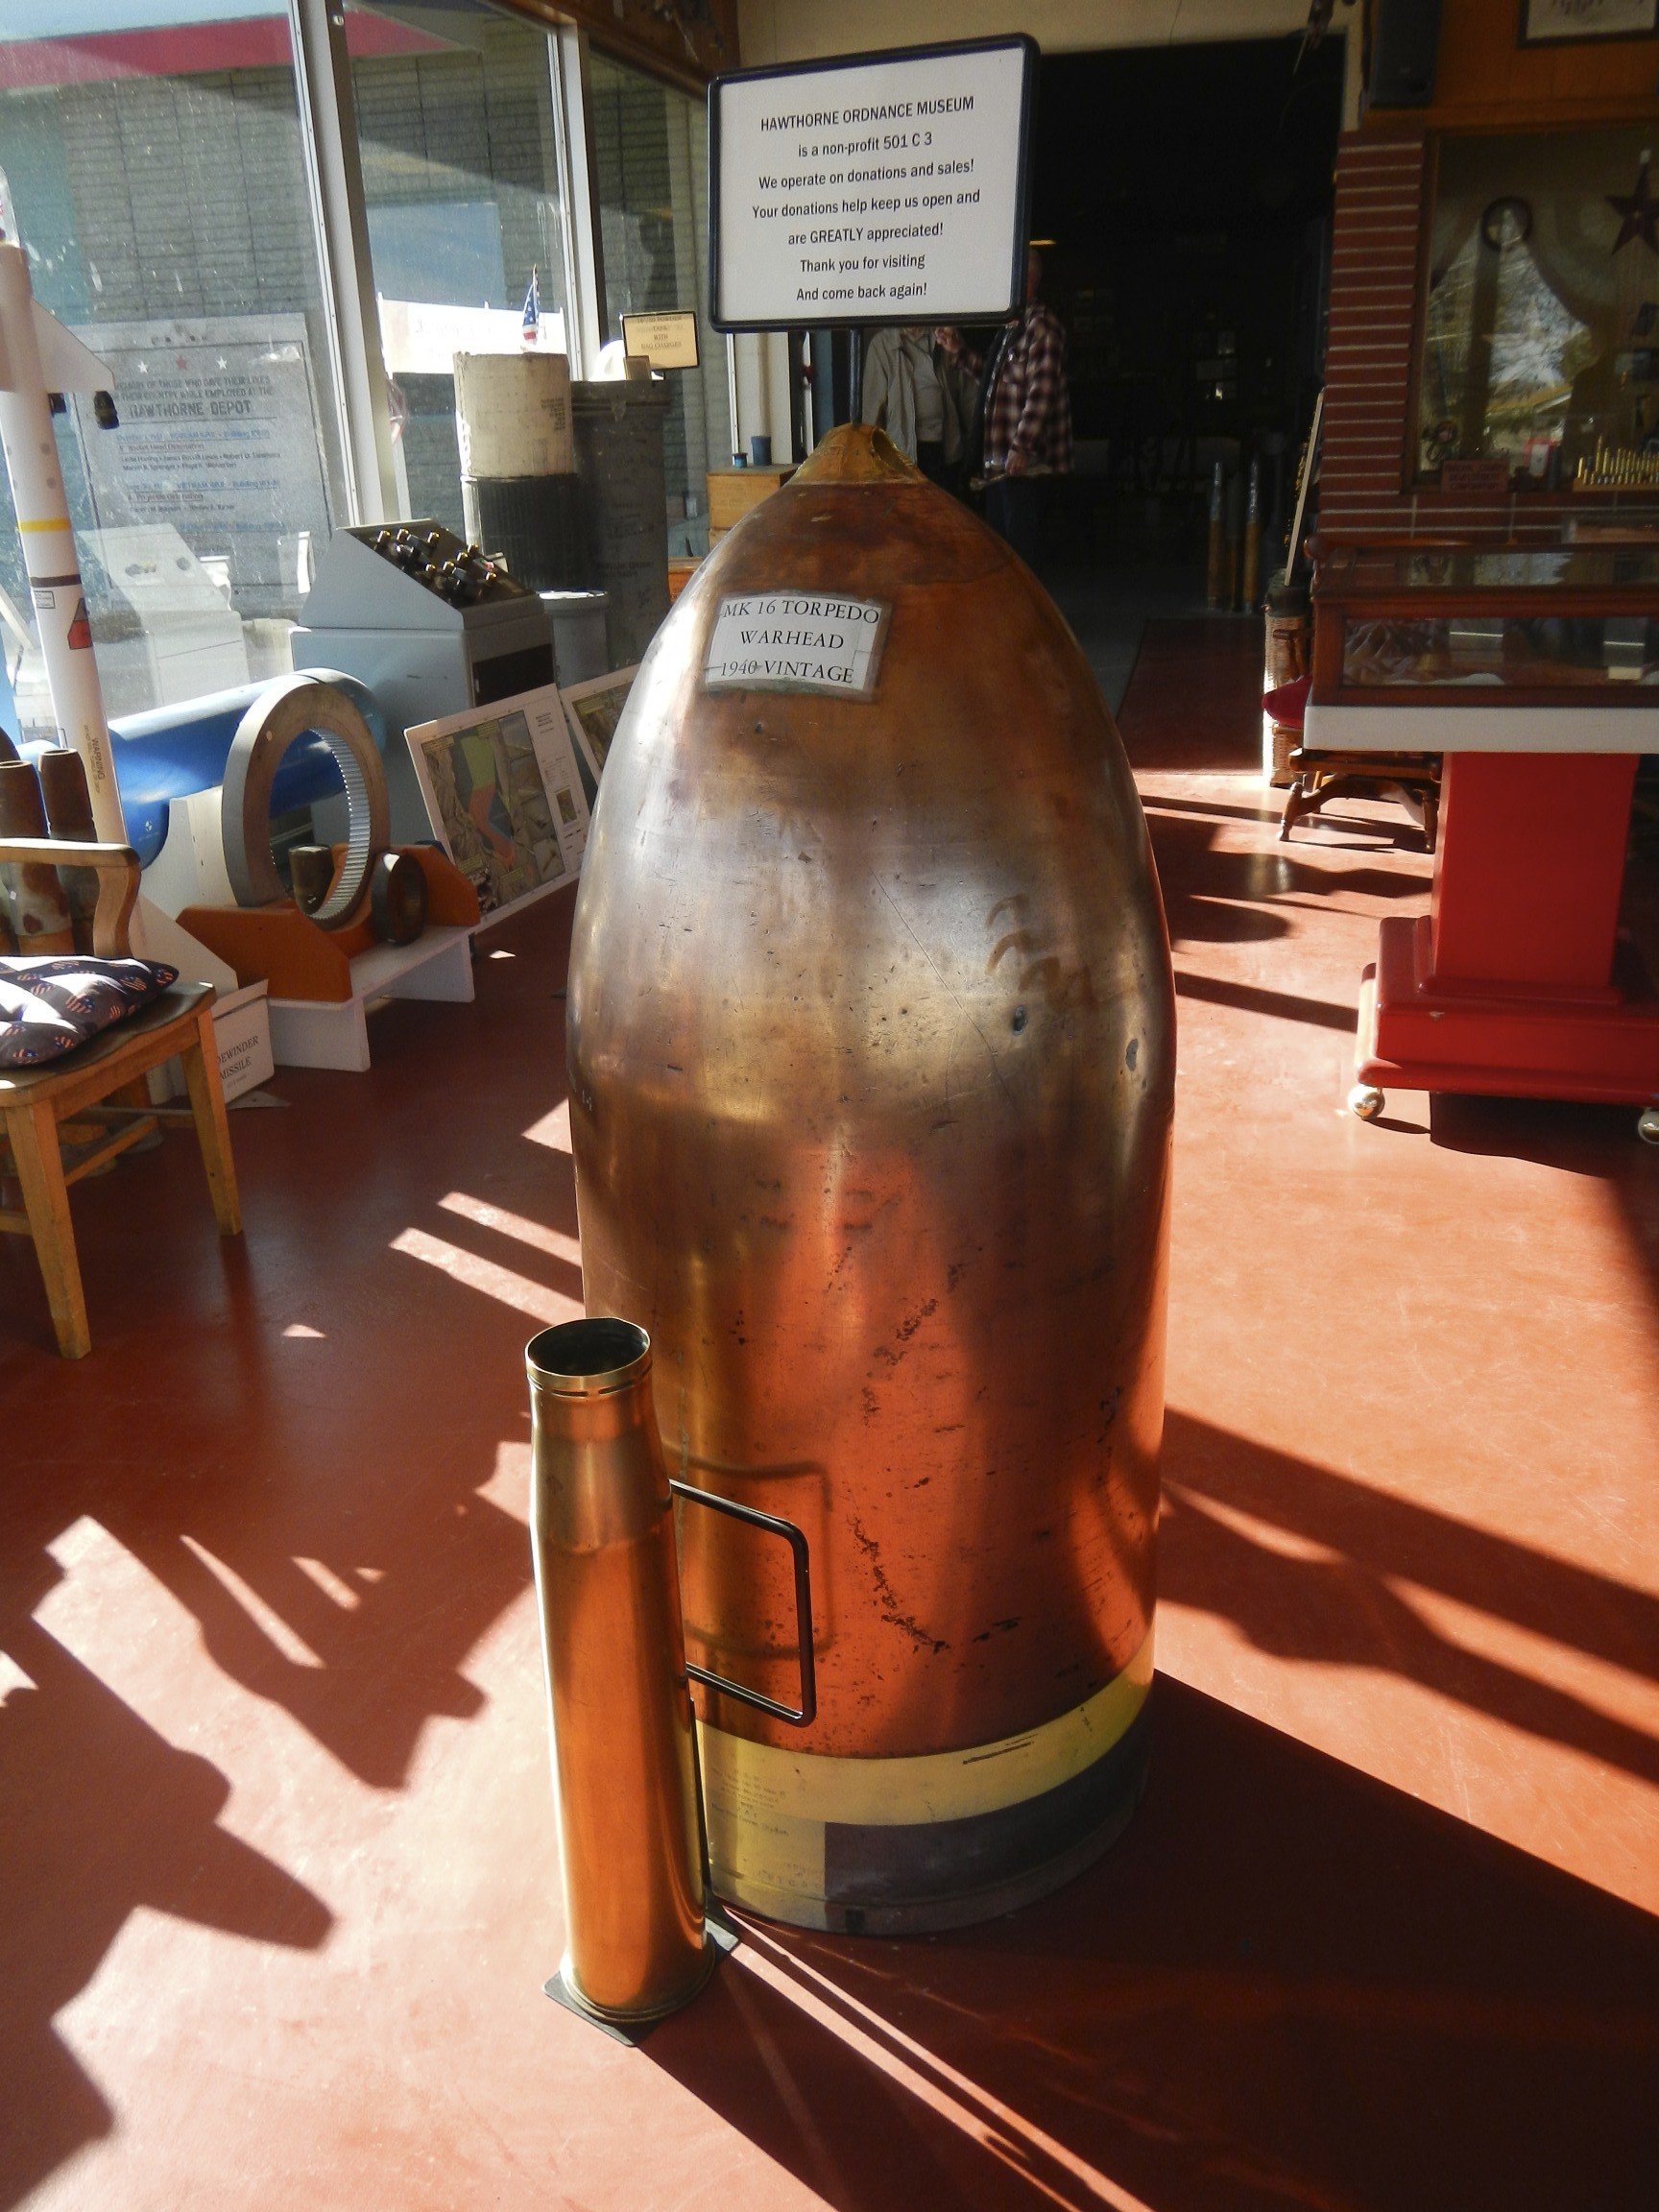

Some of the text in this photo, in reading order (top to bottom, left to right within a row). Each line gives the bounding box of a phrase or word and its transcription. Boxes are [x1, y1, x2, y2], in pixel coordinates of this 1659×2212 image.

[760, 96, 974, 131] HAWTHORNE ORDNANCE MUSEUM
[798, 132, 932, 157] is a non-profit 501 C 3
[758, 158, 974, 189] We operate on donations and sales!
[752, 190, 980, 218] Your donations help keep us open and
[788, 223, 944, 245] are GREATLY appreciated!
[801, 254, 926, 274] Thank you for visiting
[797, 283, 926, 301] And come back again!
[204, 388, 247, 397] EMPLOYED
[130, 399, 252, 418] HAWTHORNE DEPOT
[723, 599, 879, 624] MK 16 TORPEDO
[740, 630, 844, 649] WARHEAD
[721, 659, 854, 684] 1940 VINTAGE
[92, 738, 105, 780] WARNING
